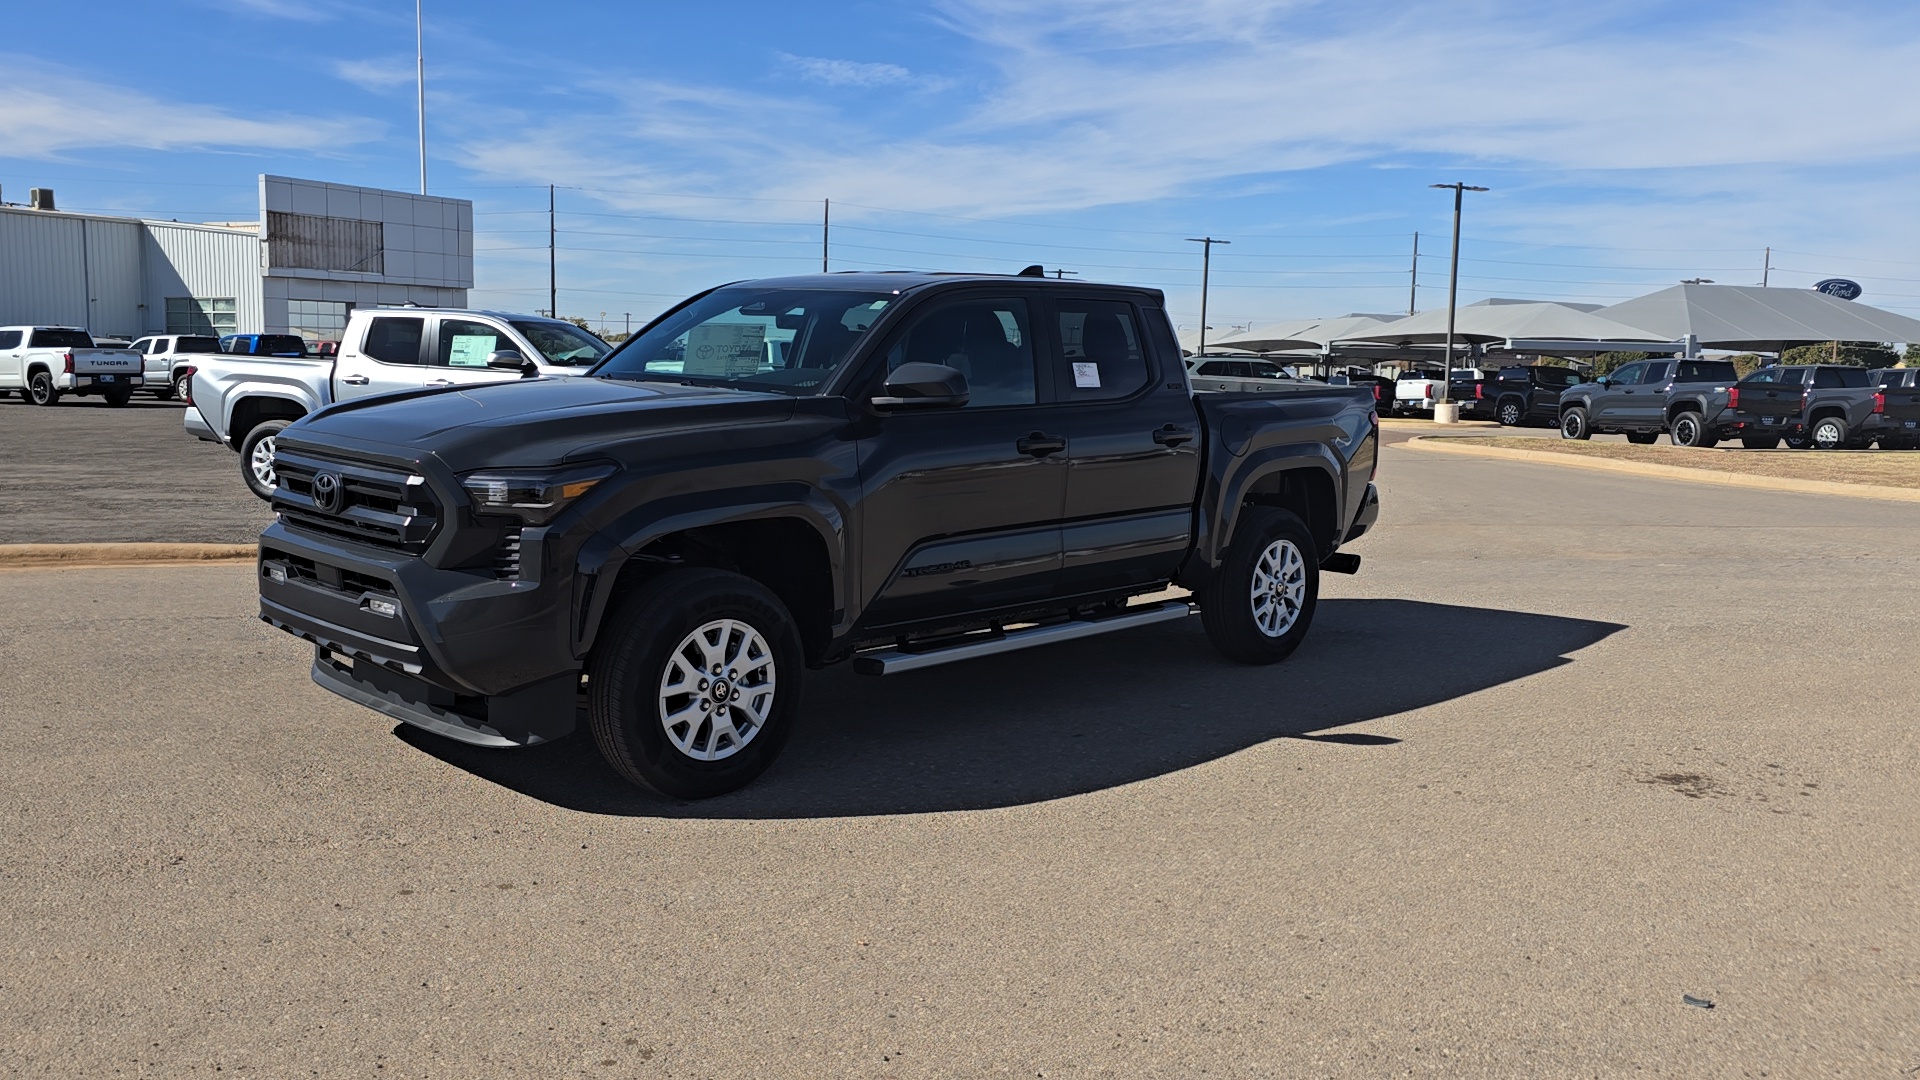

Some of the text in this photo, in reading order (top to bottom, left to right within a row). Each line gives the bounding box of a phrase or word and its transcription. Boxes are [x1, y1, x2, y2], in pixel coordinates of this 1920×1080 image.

[1825, 282, 1854, 297] Ford
[716, 344, 752, 354] TOYOTA
[904, 559, 972, 576] TACOMA
